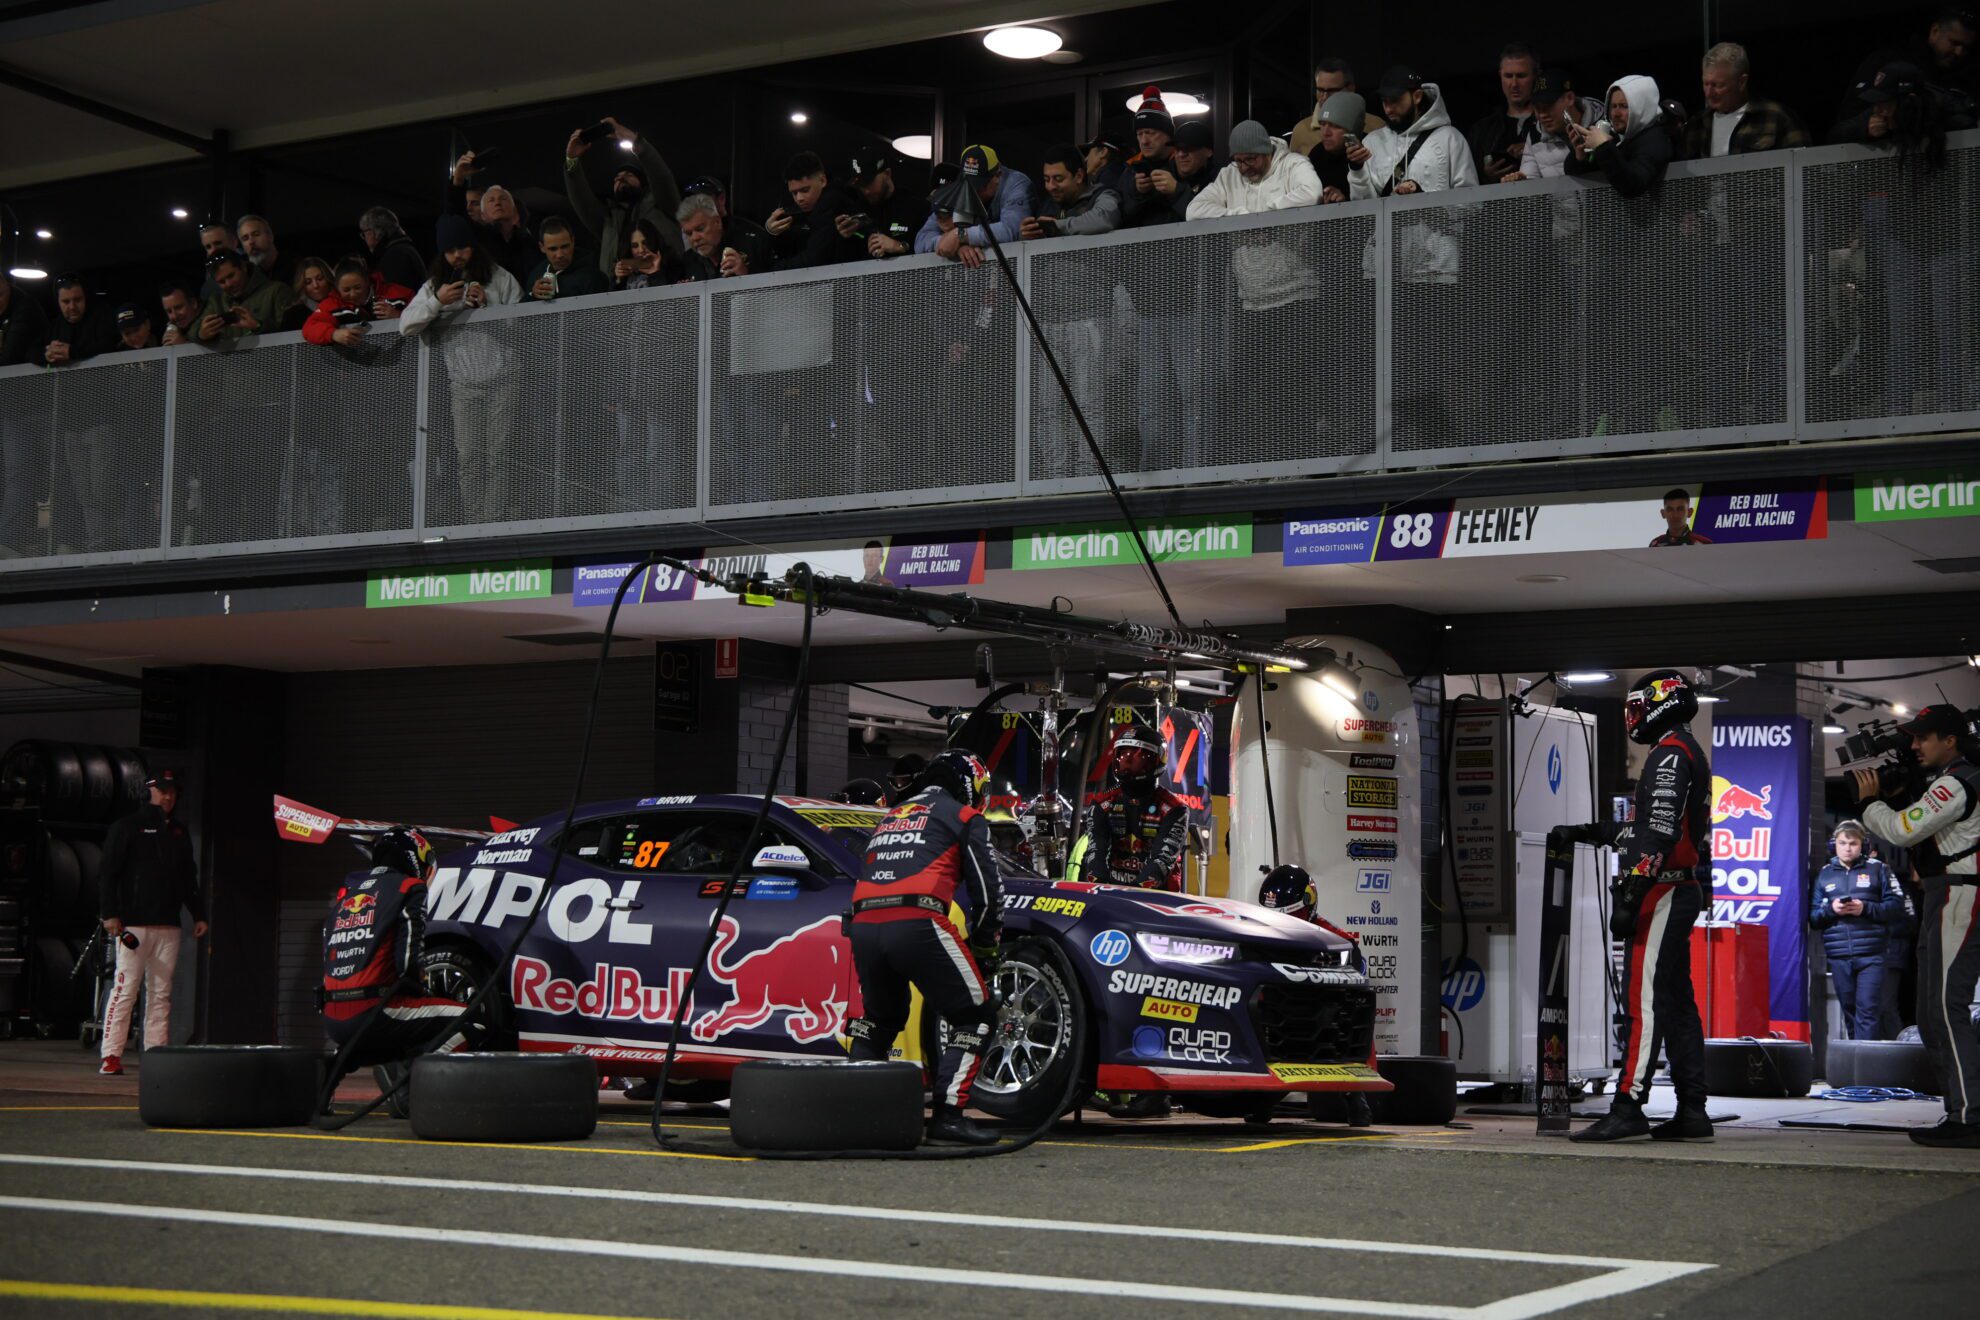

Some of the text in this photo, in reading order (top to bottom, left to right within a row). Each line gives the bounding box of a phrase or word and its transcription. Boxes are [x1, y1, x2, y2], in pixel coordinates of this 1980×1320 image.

[1729, 493, 1779, 510] RED BULL
[1289, 517, 1370, 536] Panasonic
[1455, 506, 1539, 544] FEENEY
[1715, 510, 1795, 529] AMPOL RACING
[1147, 523, 1239, 553] Merlin
[1390, 513, 1433, 548] 88
[911, 543, 949, 560] RED BULL
[1031, 531, 1119, 561] Merlin
[1295, 543, 1364, 553] AIR CONDITIONING
[578, 564, 633, 581] Panasoni
[900, 559, 960, 576] AMPOL RACING
[380, 572, 449, 601] Merlin
[469, 566, 540, 595] Merlin
[1114, 706, 1133, 724] 88
[1646, 696, 1680, 723] AMPOL
[1002, 712, 1019, 729] 87
[1344, 717, 1398, 732] SUPERCHEAP
[1728, 725, 1792, 747] WINGS
[1350, 779, 1395, 791] NATIONAL
[656, 794, 697, 805] BROWN
[1353, 792, 1395, 804] STORAGE
[275, 804, 334, 831] SUPERCHEAP
[898, 815, 928, 832] Bull
[288, 822, 310, 834] AUTO
[486, 827, 541, 846] Harvey
[1713, 827, 1772, 862] Bull
[471, 848, 532, 865] Norman
[633, 840, 671, 868] 87
[760, 852, 807, 861] ACDelco
[871, 870, 897, 880] JOEL
[1360, 873, 1389, 889] JGI
[1712, 868, 1782, 895] POL
[1016, 895, 1034, 909] IT
[1032, 896, 1086, 918] SUPER
[1346, 916, 1398, 925] NEW HOLLAND
[328, 927, 374, 946] AMPOL
[1095, 930, 1128, 966] hp
[1369, 956, 1396, 967] QUAD
[331, 964, 355, 977] JORDY
[1369, 968, 1396, 978] LOCK
[1108, 969, 1242, 1010] SUPERCHEAP
[1147, 1001, 1193, 1018] AUTO
[1375, 1008, 1396, 1016] PLIFY
[1168, 1027, 1232, 1049] QUAD
[587, 1047, 618, 1058] NEW
[1168, 1047, 1233, 1065] LOCK
